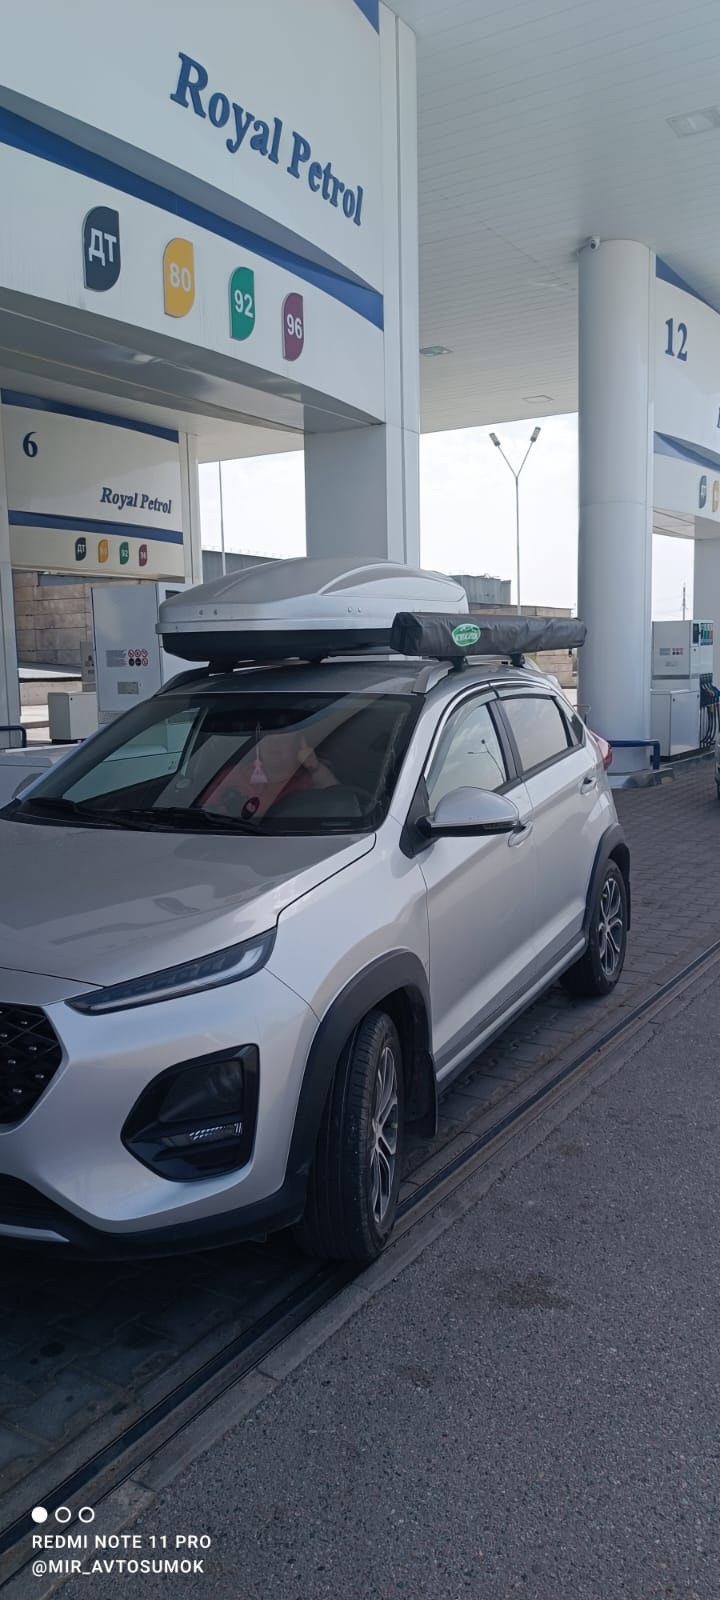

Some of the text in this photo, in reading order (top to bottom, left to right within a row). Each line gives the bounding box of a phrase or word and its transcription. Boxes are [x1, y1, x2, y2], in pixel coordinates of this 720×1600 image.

[170, 52, 364, 226] Royal Petrol
[89, 228, 117, 266] ДТ
[169, 263, 191, 292] 80
[234, 290, 254, 318] 92
[286, 314, 303, 339] 96
[665, 318, 688, 361] 12
[22, 431, 38, 458] 6
[100, 487, 172, 514] Royal Petrol
